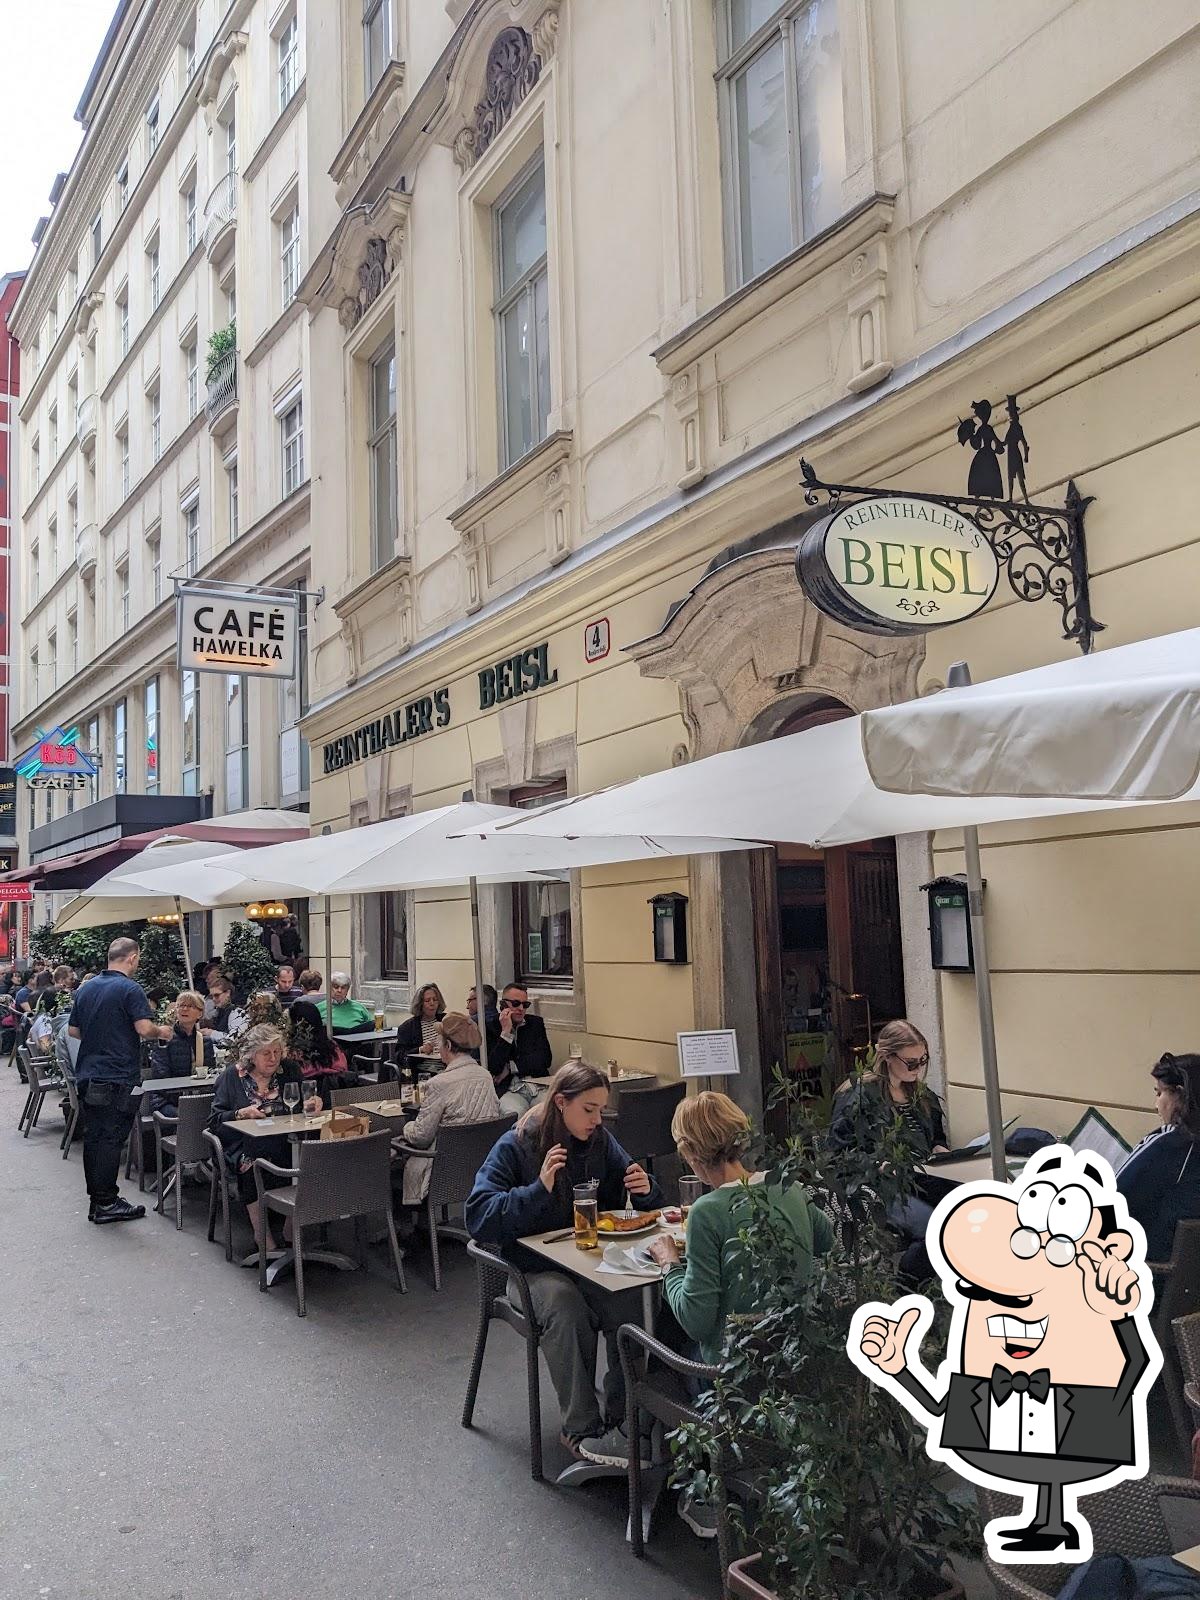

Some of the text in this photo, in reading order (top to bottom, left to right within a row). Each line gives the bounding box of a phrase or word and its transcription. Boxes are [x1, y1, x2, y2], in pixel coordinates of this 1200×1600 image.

[837, 537, 989, 596] BEISL
[193, 607, 285, 641] CAFÉ
[592, 625, 601, 647] 4
[193, 636, 283, 660] HAWELKA
[322, 642, 559, 774] REINTHALER'S BEISL
